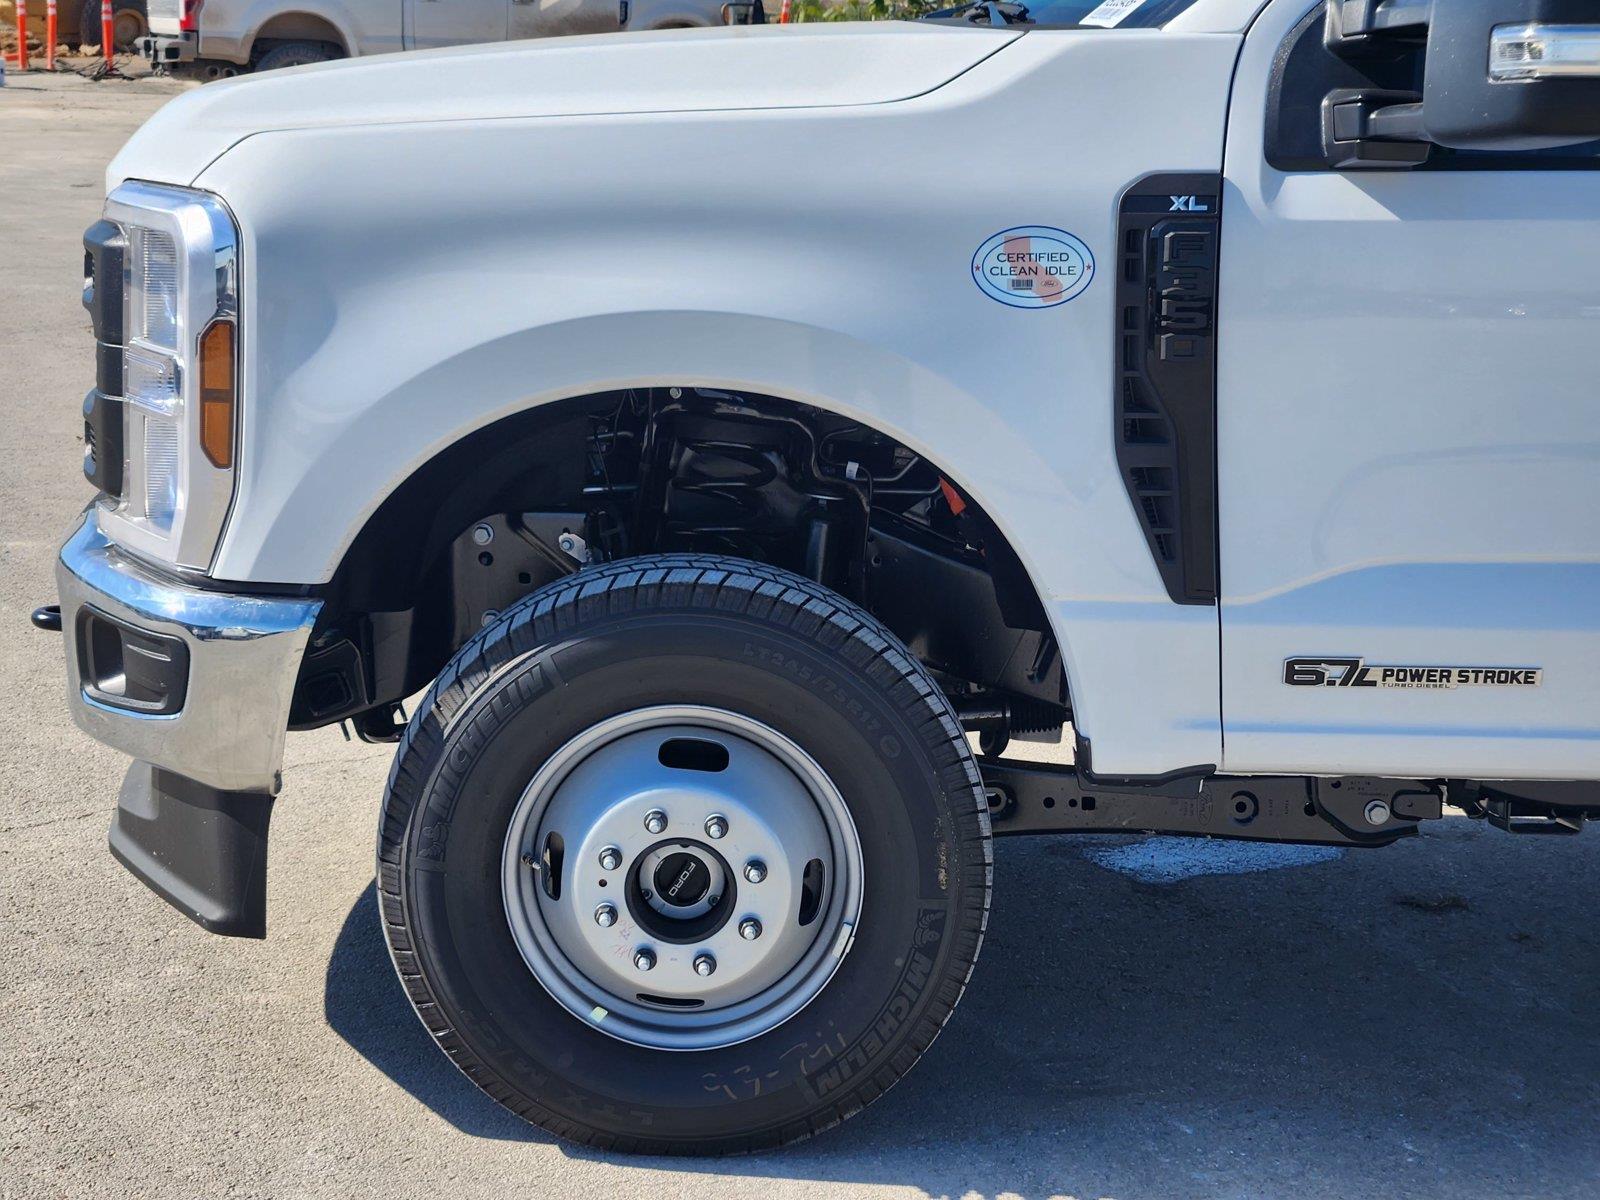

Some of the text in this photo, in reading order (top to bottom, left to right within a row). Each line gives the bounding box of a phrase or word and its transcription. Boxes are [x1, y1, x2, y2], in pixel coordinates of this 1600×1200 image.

[1169, 195, 1208, 211] XL
[989, 265, 1077, 276] CLEAN IDLE
[996, 252, 1070, 263] CERTIFIED
[1284, 657, 1537, 687] 6.7L POWER STROKE
[428, 664, 546, 818] MICHELIN
[668, 861, 697, 897] FORD
[816, 951, 933, 1094] MICHELIN
